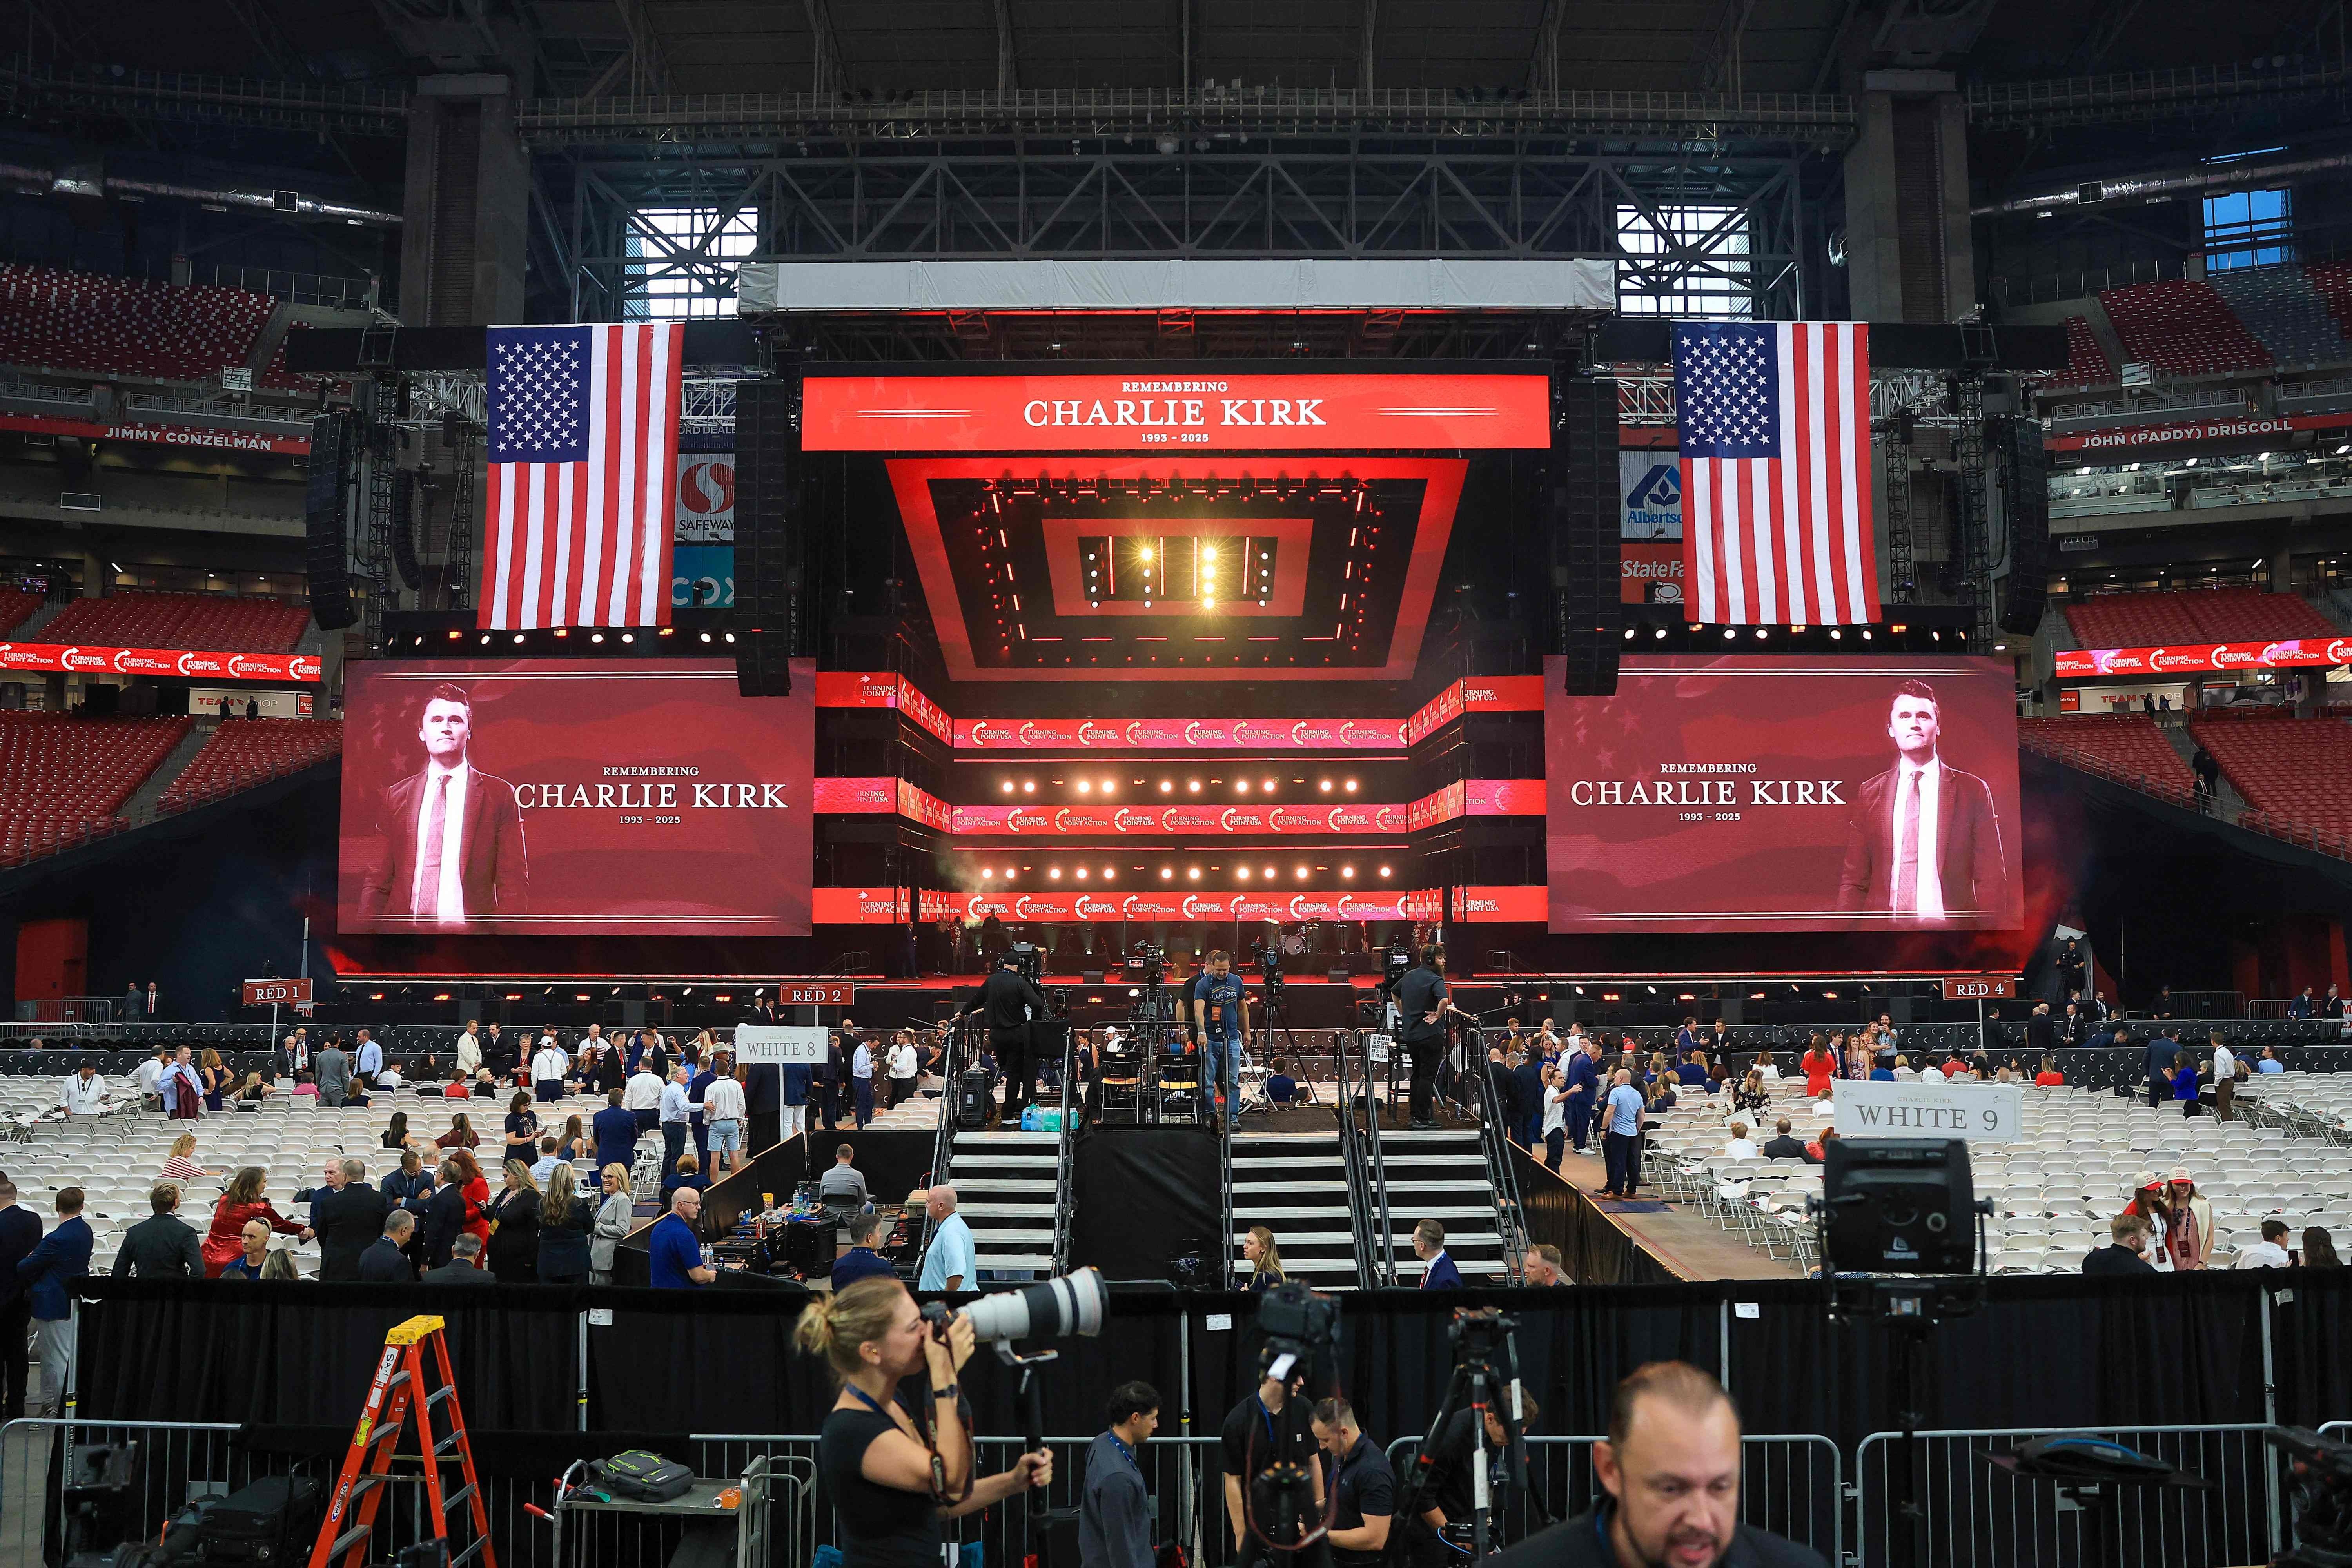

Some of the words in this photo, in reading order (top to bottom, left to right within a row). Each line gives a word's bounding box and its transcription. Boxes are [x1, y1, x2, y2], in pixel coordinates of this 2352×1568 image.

[1122, 381, 1228, 393] REMEMBERING
[1024, 399, 1205, 427] CHARLIE
[1220, 399, 1327, 426] KIRK
[105, 427, 160, 441] JIMMY
[166, 432, 271, 450] CONZELMAN
[1140, 433, 1167, 443] 1993
[1181, 433, 1209, 443] 2025
[2082, 434, 2125, 448] JOHN
[2131, 428, 2202, 445] (PADDY)
[2208, 420, 2293, 437] DRISCOLL
[679, 519, 734, 530] SAFEWAY
[1622, 560, 1667, 577] State
[2101, 695, 2136, 703] TEAM
[603, 766, 699, 776] REMEMBERING
[1660, 764, 1757, 773] REMEMBERING
[515, 783, 677, 809] CHARLIE
[692, 784, 788, 808] KIRK
[1571, 780, 1737, 806] CHARLIE
[1750, 780, 1846, 805] KIRK
[619, 815, 642, 824] 1993
[655, 815, 681, 824] 2025
[1679, 813, 1703, 821] 1993
[1715, 813, 1740, 821] 2025
[255, 987, 287, 1000] RED
[292, 986, 299, 998] 1
[792, 990, 826, 1001] RED
[832, 990, 841, 1001] 2
[1956, 984, 1989, 996] RED
[1994, 983, 2004, 995] 4
[746, 1042, 800, 1056] WHITE
[808, 1042, 815, 1056] 8
[1855, 1105, 1967, 1129] WHITE
[1982, 1109, 1998, 1131] 9
